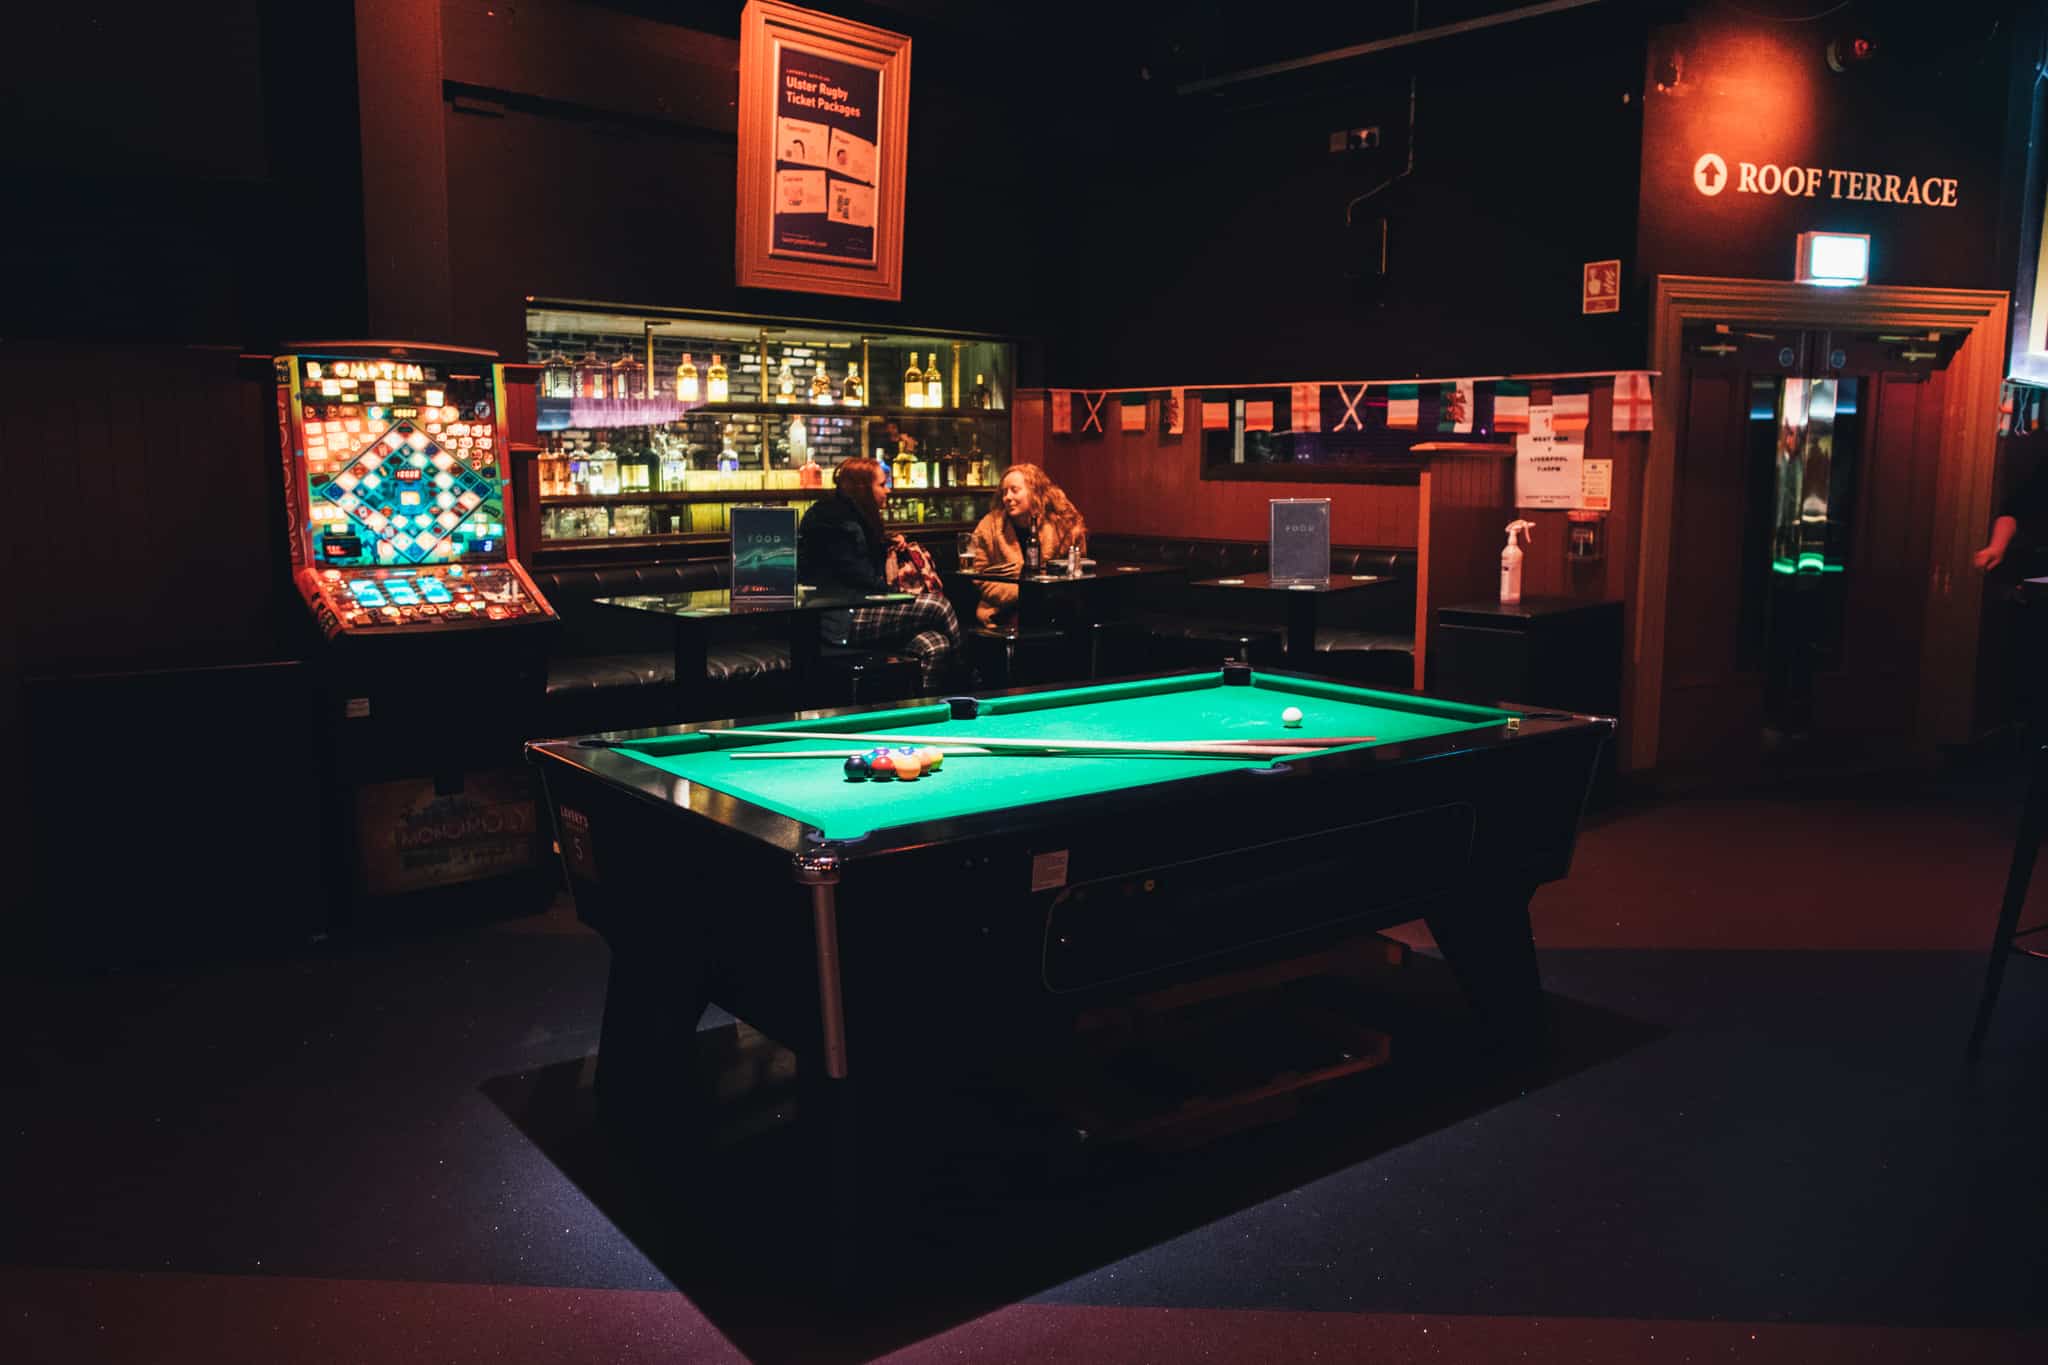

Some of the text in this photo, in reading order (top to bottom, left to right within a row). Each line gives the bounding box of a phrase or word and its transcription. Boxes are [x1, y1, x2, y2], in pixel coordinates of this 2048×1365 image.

[786, 75, 818, 92] Ulster
[819, 82, 849, 102] Rugby
[786, 90, 861, 117] Ticket Packages
[1737, 162, 1958, 208] ROOF TERRACE
